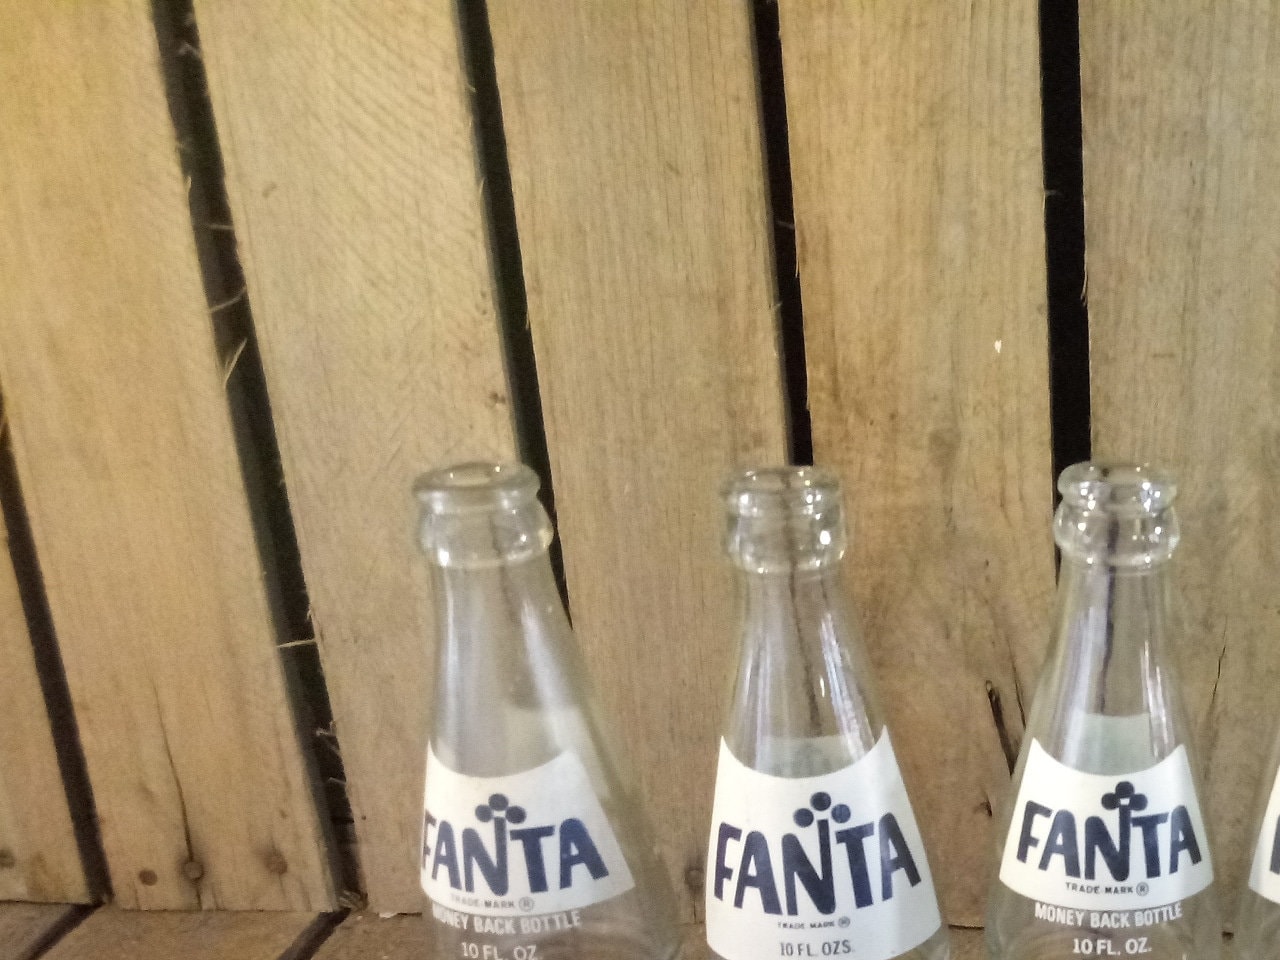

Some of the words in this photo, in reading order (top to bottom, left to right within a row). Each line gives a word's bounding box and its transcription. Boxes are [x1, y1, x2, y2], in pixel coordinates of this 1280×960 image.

[422, 808, 610, 897] FANTA
[1016, 800, 1203, 882] FANTA
[714, 812, 922, 916] FANTA
[1065, 881, 1100, 894] TRADE
[1104, 885, 1133, 895] MARK
[433, 903, 469, 930] NEY
[473, 916, 517, 936] BACK
[520, 910, 582, 935] BOTTLE
[1035, 901, 1084, 927] MONEY
[1090, 911, 1131, 929] BACK
[1134, 901, 1183, 927] BOTTLE
[461, 941, 480, 959] 10
[780, 942, 794, 957] 10
[1072, 937, 1093, 955] 10
[1096, 939, 1121, 956] FL.
[1125, 937, 1153, 954] OZ.
